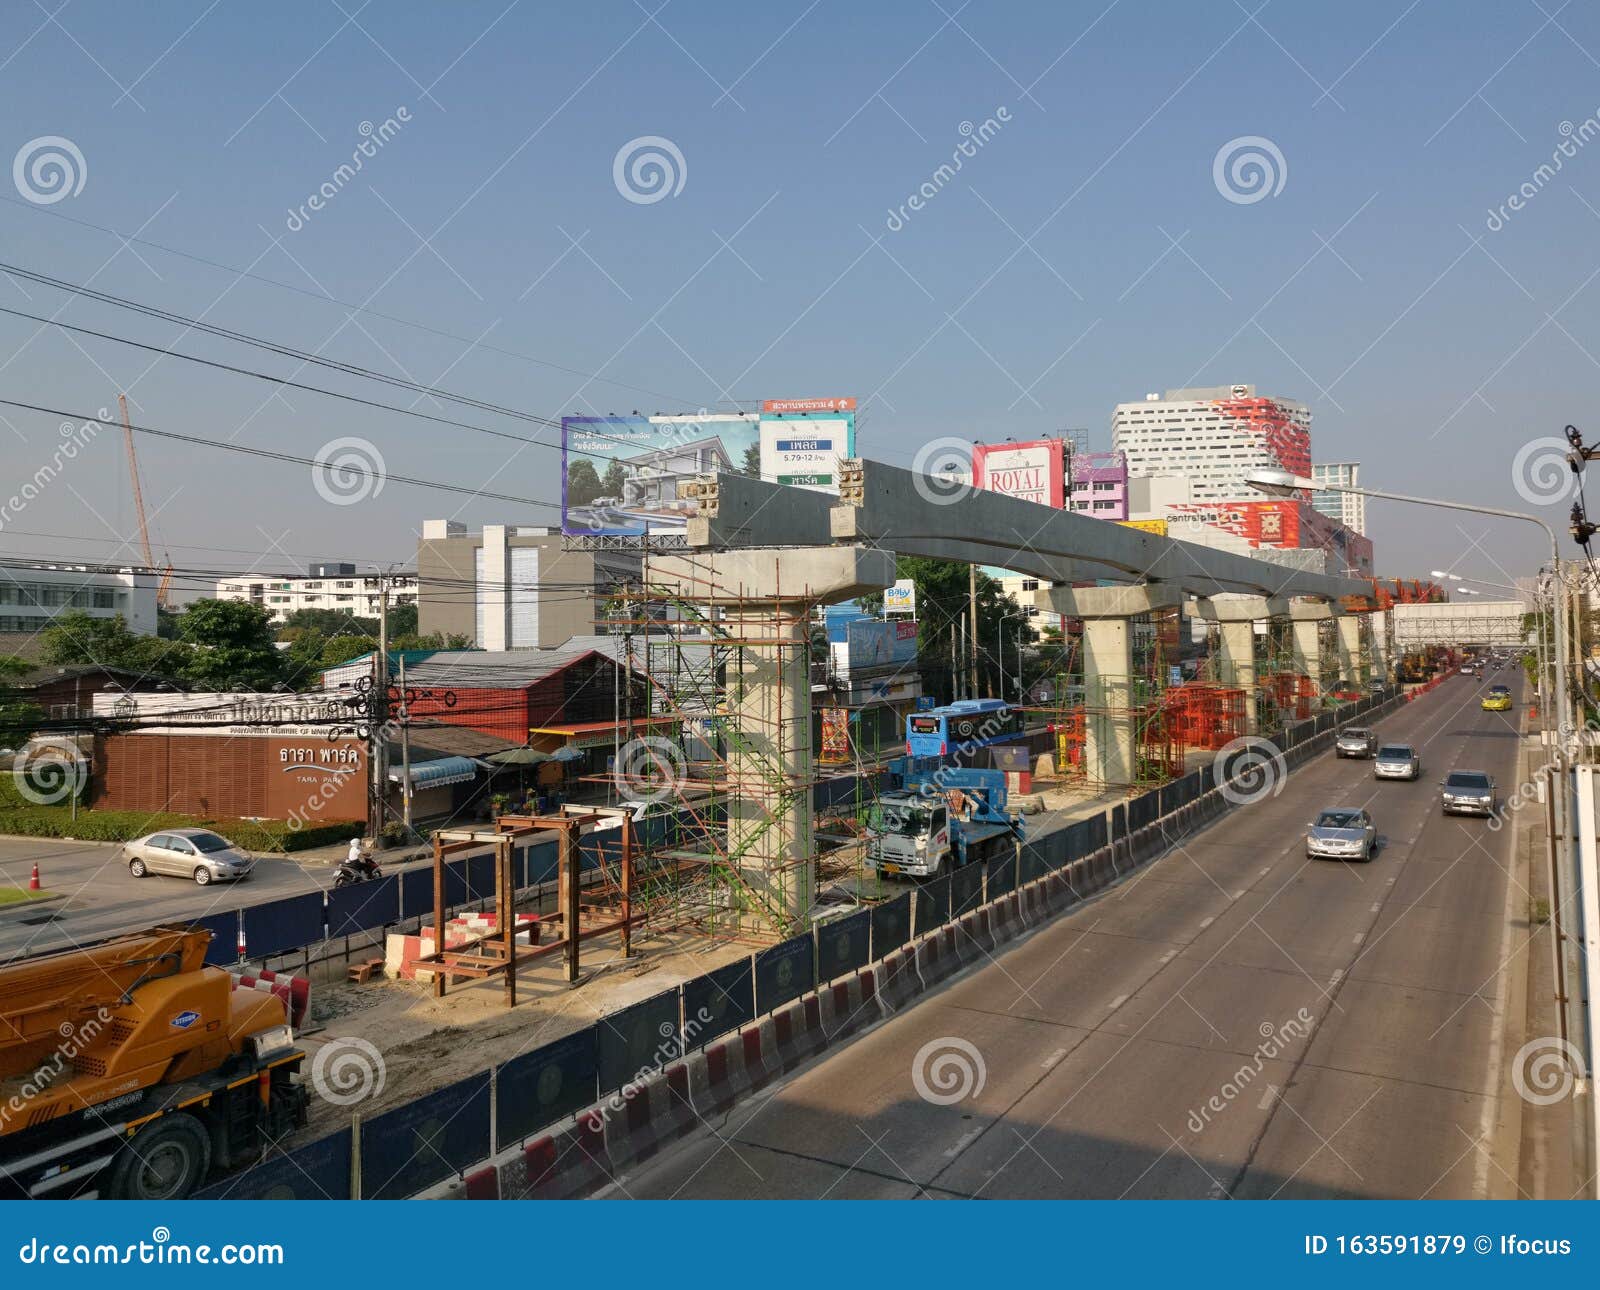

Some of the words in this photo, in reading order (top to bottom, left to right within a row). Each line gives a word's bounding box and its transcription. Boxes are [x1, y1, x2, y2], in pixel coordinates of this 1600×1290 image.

[791, 441, 817, 449] เพลส
[991, 468, 1044, 494] ROYAL
[280, 747, 314, 762] ธารา
[320, 744, 358, 763] พาร์ค
